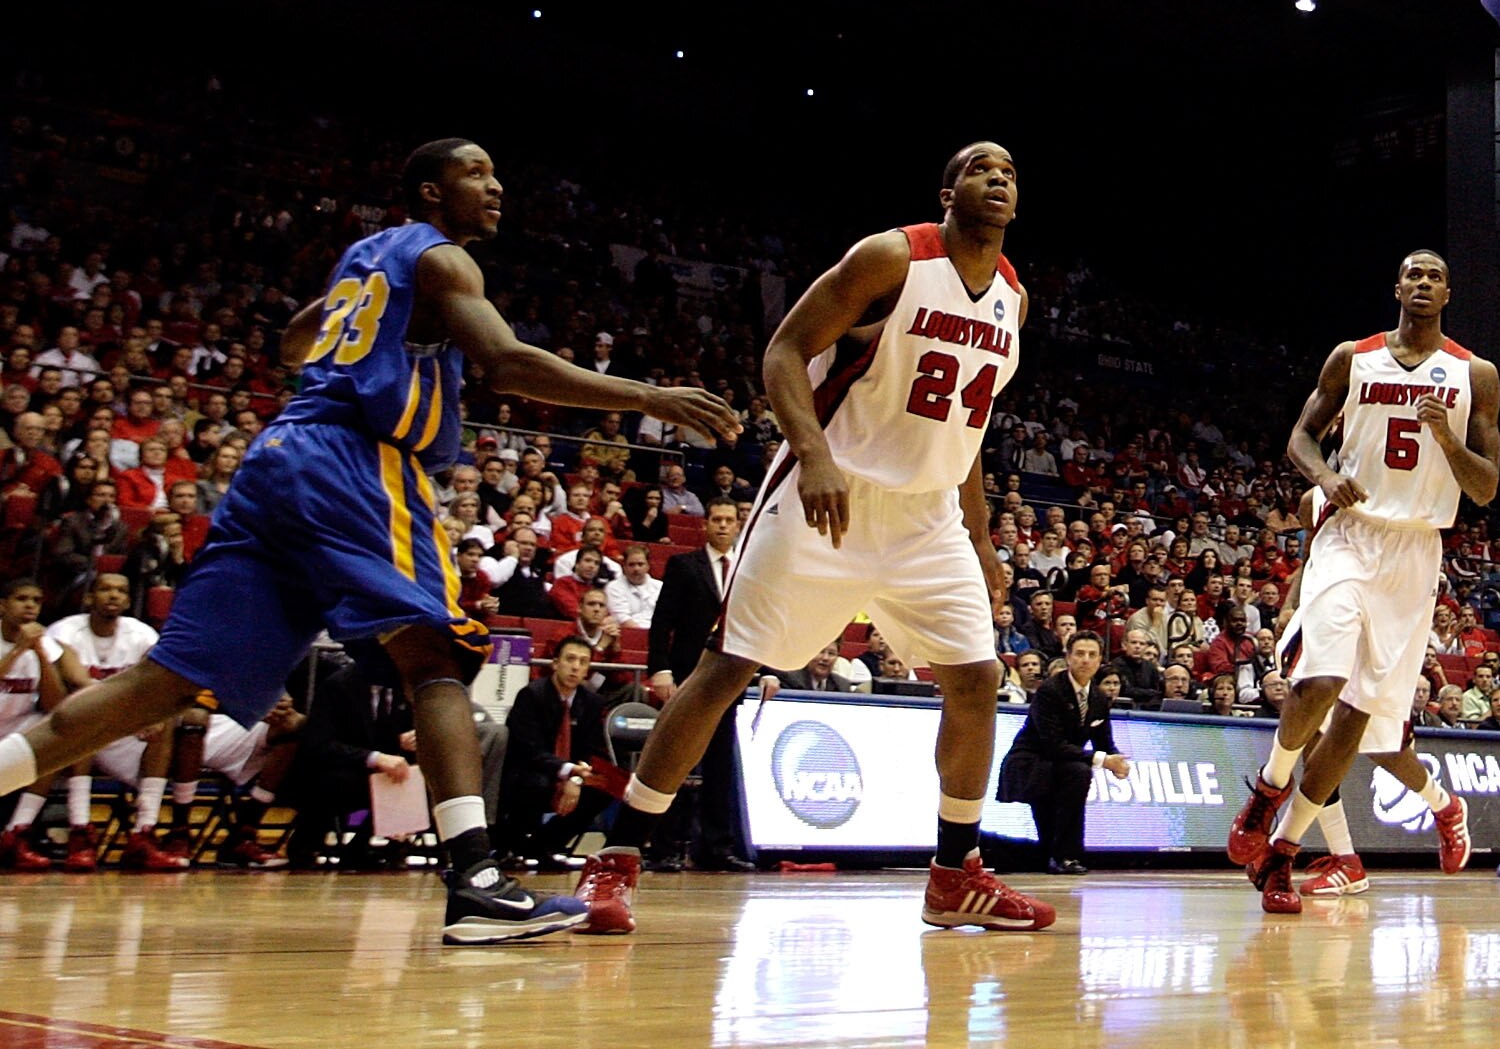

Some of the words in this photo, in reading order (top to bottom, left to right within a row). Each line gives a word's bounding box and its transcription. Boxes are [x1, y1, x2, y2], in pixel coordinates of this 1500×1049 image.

[303, 270, 391, 366] 33
[905, 306, 1013, 360] LOUISVILLE
[905, 349, 999, 429] 24
[1383, 416, 1422, 472] 5
[782, 771, 863, 802] NCAA
[1086, 759, 1225, 805] ISVILLE
